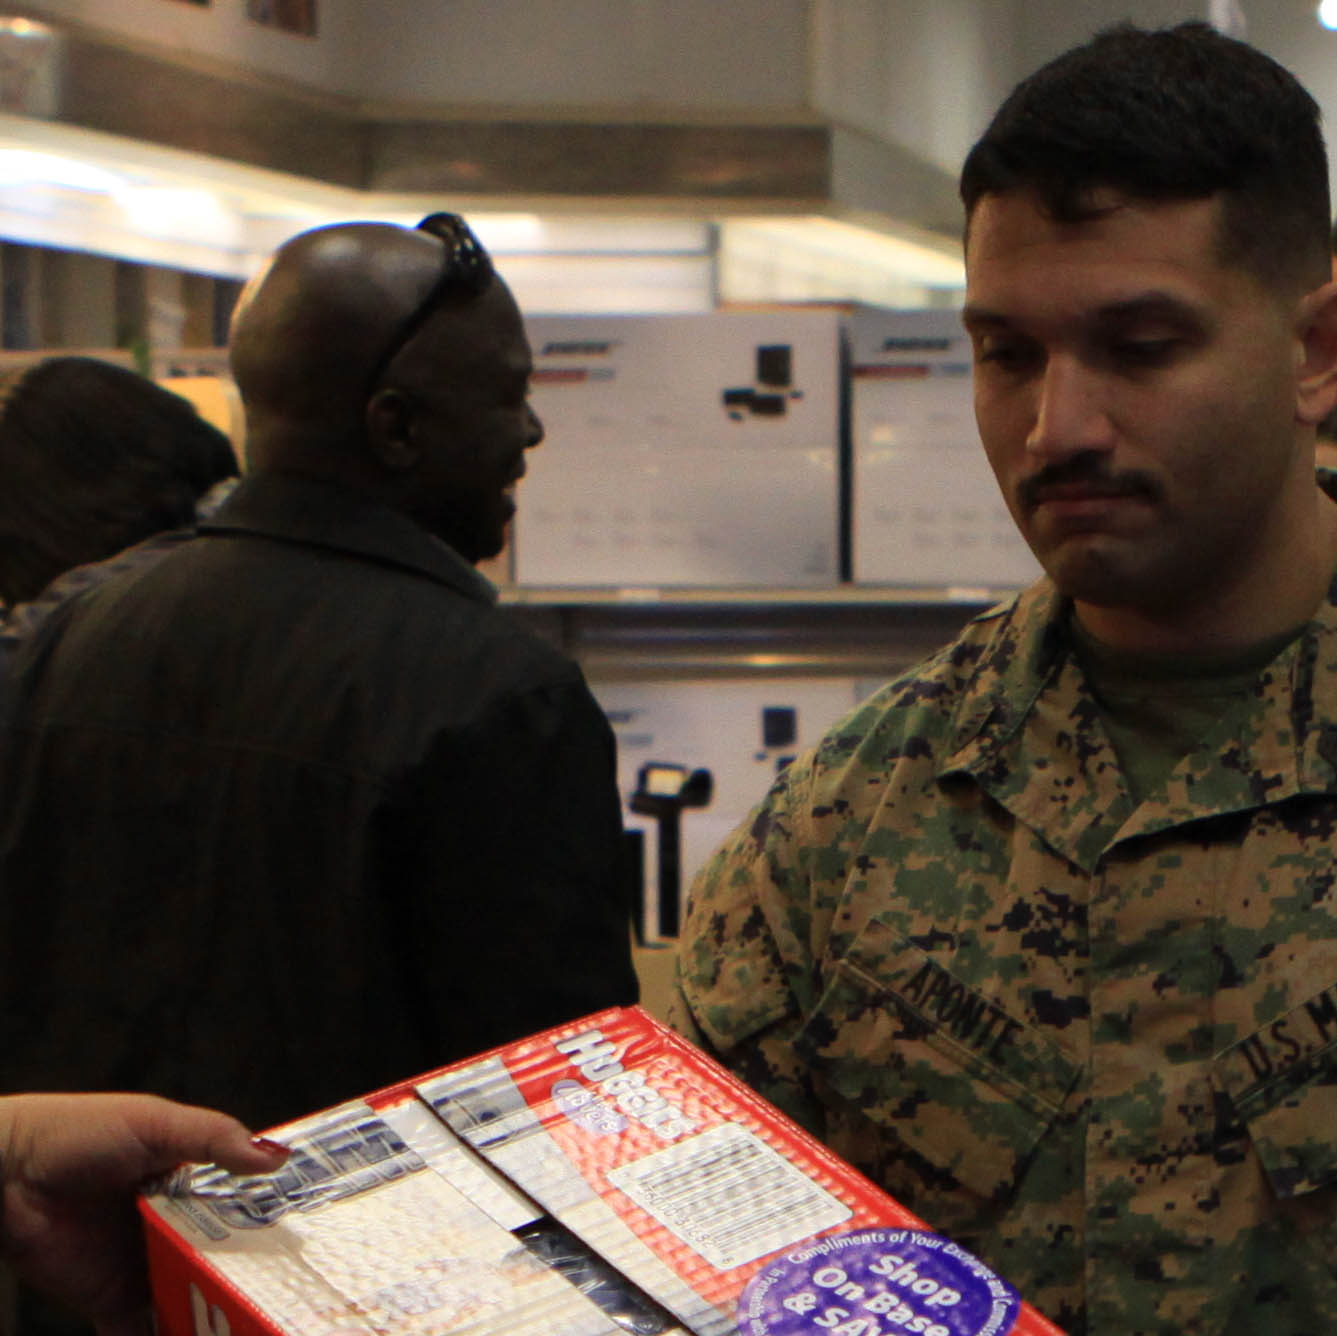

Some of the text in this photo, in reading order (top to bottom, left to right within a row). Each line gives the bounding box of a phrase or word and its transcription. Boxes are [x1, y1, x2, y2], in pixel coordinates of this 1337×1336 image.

[900, 957, 1024, 1065] APONTE
[1240, 1019, 1314, 1080] U.S.
[555, 1030, 697, 1140] HUGGIES
[787, 1232, 885, 1265] Compliments
[890, 1230, 907, 1244] of
[911, 1231, 944, 1249] Your
[943, 1243, 997, 1281] Exchange
[868, 1254, 962, 1307] Shop
[783, 1291, 817, 1316] &
[812, 1267, 865, 1302] On
